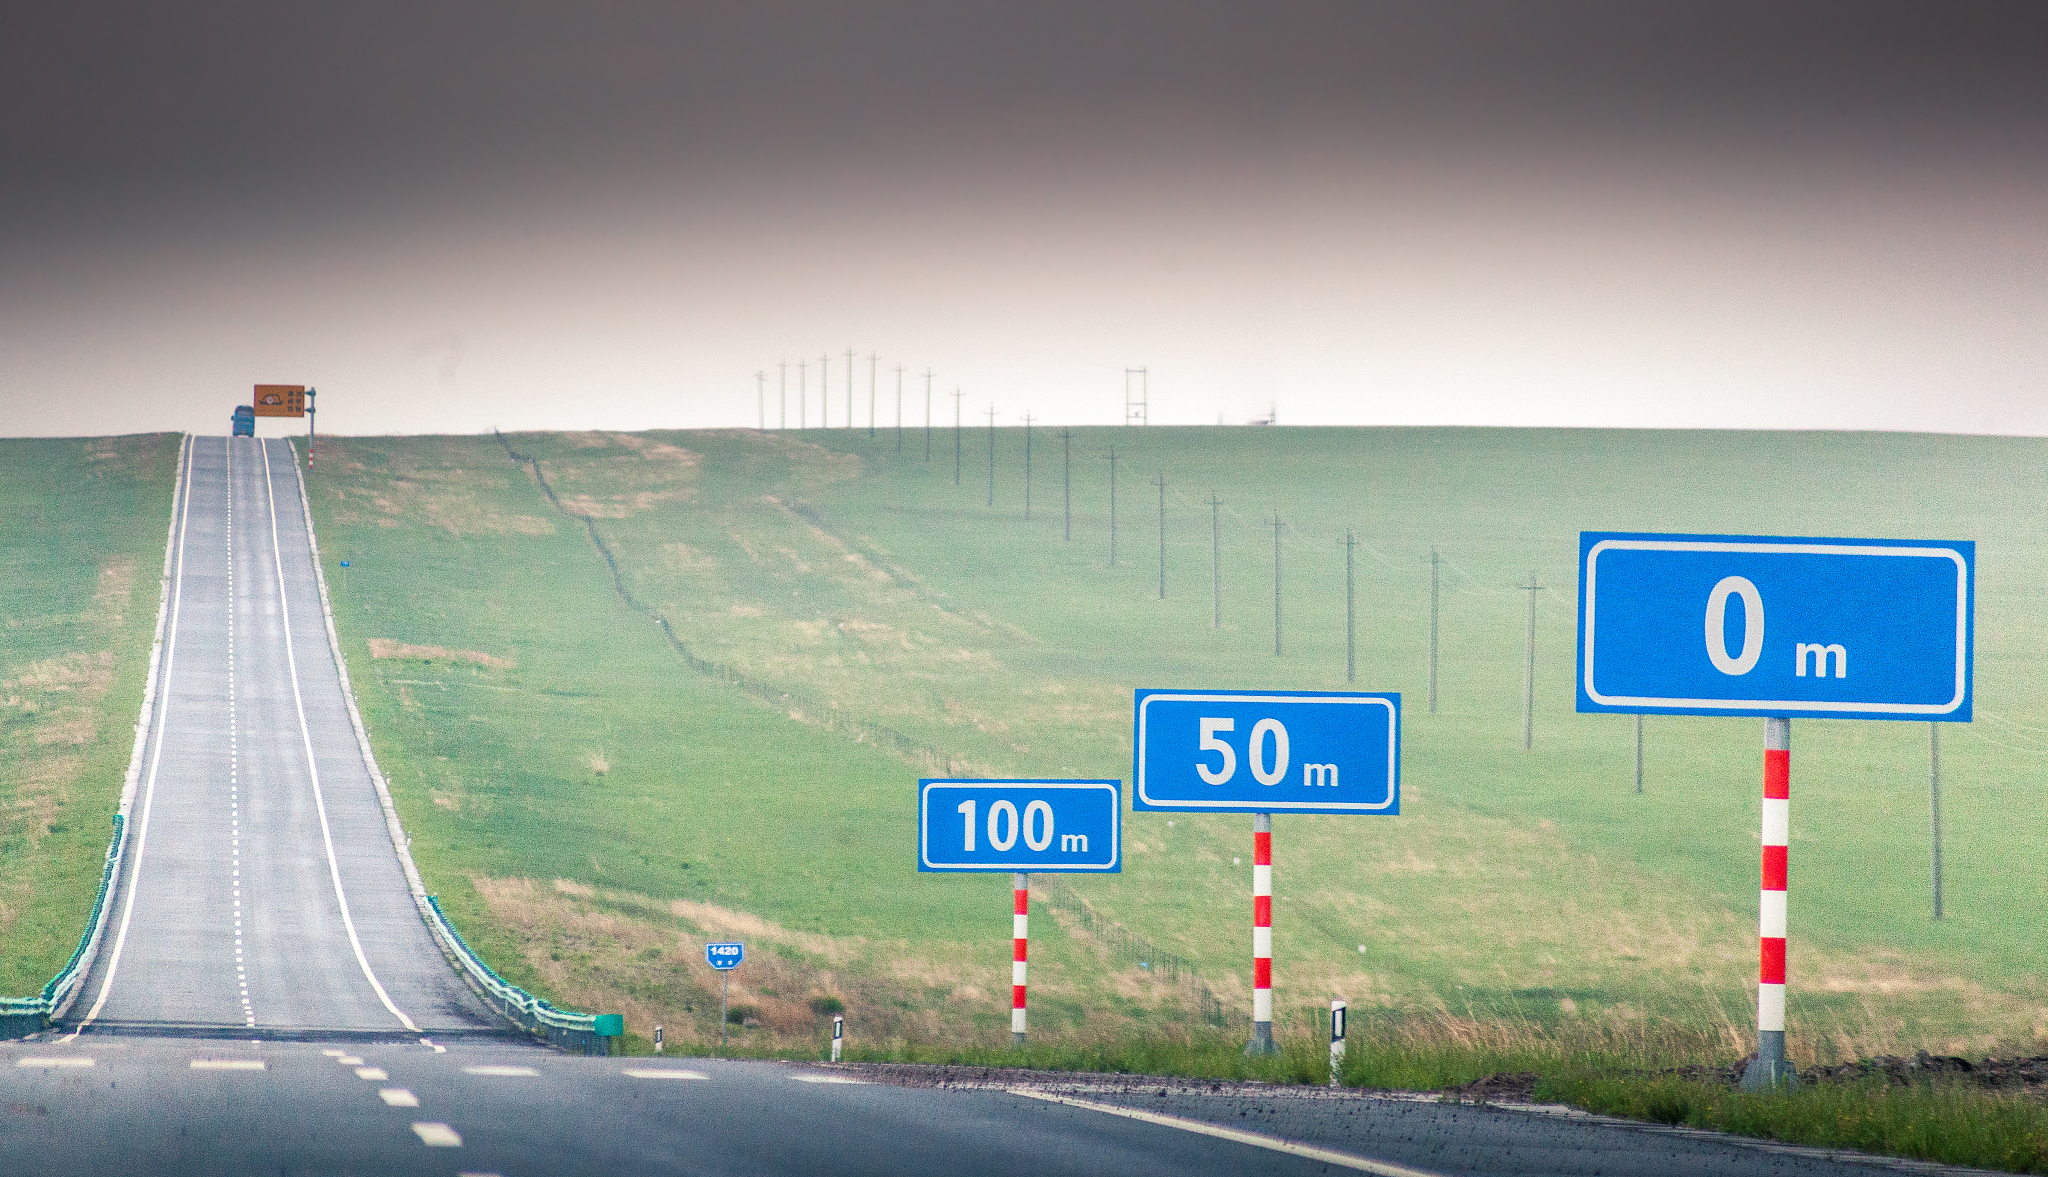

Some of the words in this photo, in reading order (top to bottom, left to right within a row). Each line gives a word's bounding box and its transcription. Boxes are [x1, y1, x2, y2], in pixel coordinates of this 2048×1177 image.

[1705, 576, 1765, 676] 0
[1796, 643, 1847, 679] m
[1196, 717, 1290, 786] 50
[1304, 764, 1338, 787] m
[958, 800, 1055, 851] 100
[1062, 835, 1088, 853] m
